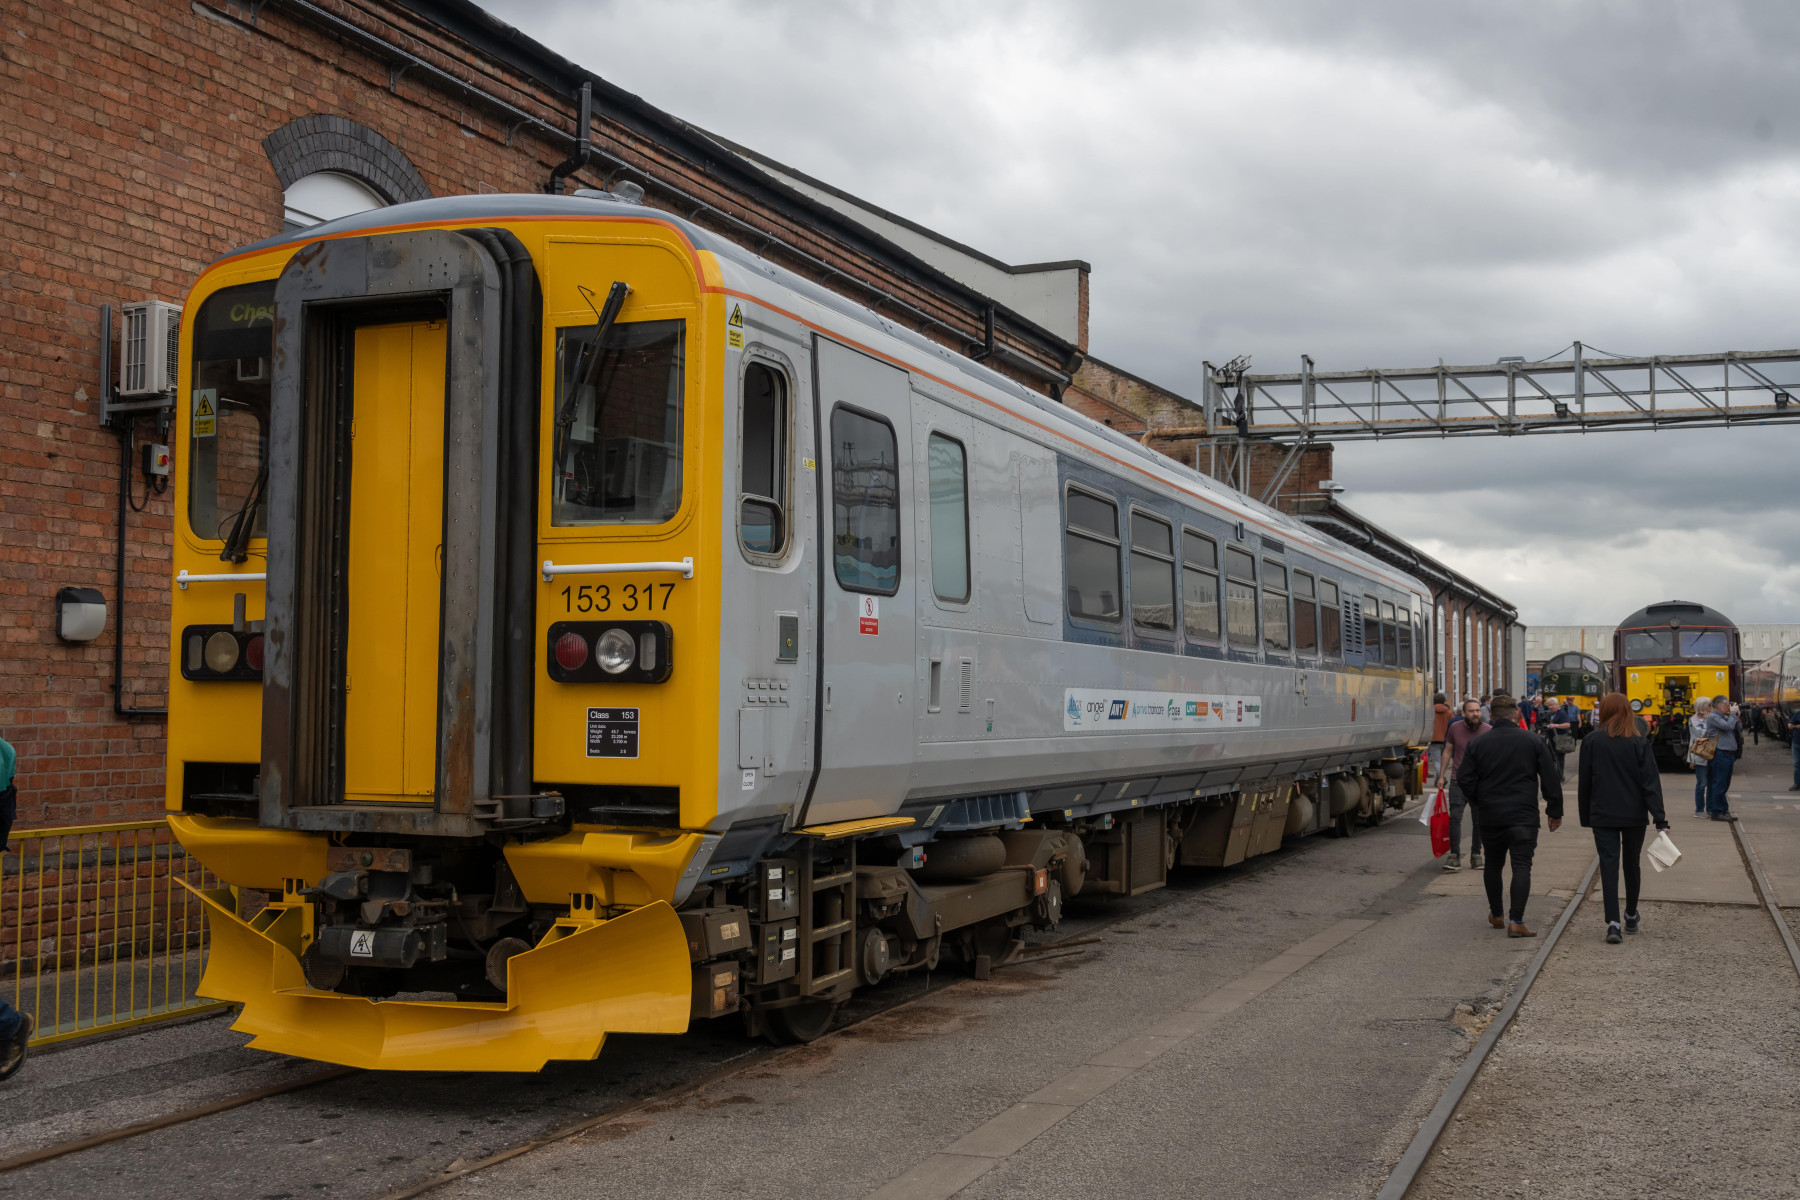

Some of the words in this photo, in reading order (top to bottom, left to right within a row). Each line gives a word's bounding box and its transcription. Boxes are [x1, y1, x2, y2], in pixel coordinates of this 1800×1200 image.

[561, 584, 611, 613] 153
[622, 582, 676, 612] 317
[1543, 684, 1556, 693] 6Z
[1086, 699, 1105, 722] angel
[1110, 703, 1124, 716] ANT
[1186, 705, 1197, 713] LNT
[590, 711, 610, 719] Class
[621, 711, 635, 719] 153
